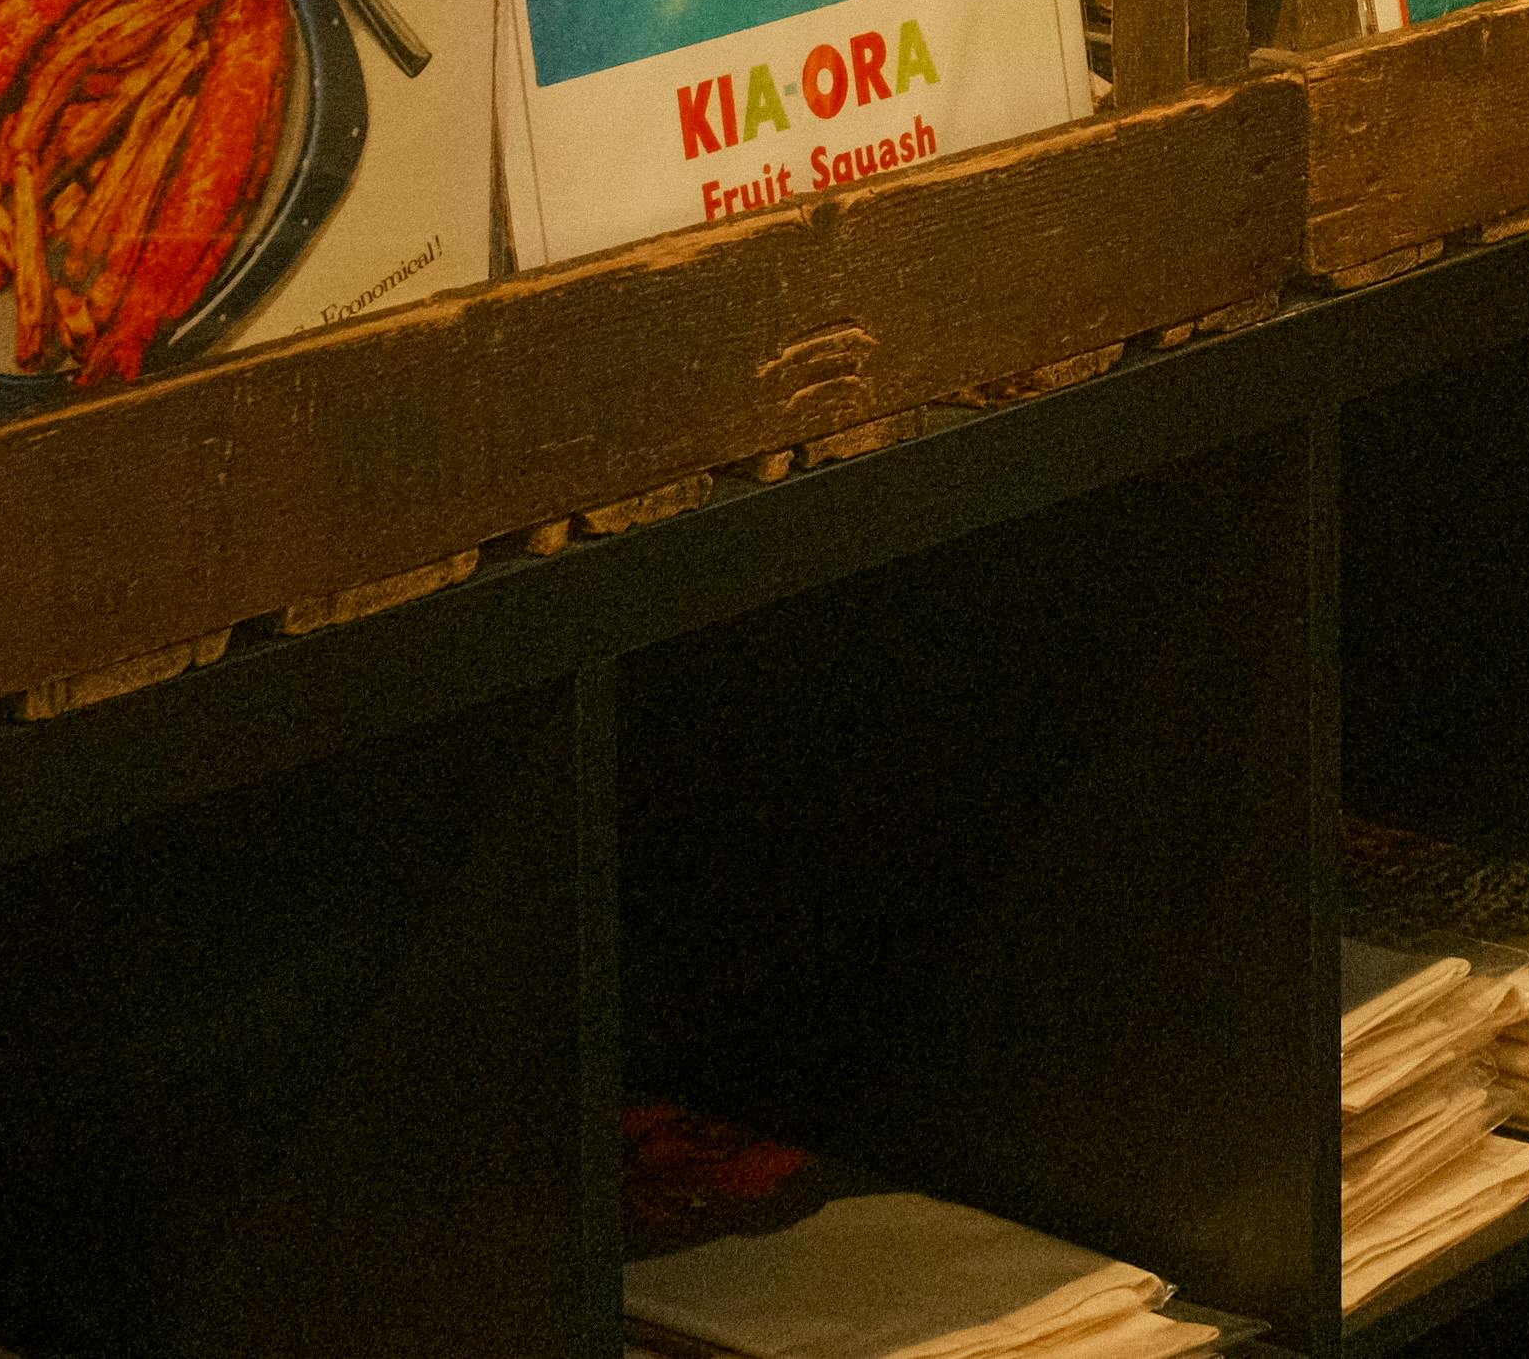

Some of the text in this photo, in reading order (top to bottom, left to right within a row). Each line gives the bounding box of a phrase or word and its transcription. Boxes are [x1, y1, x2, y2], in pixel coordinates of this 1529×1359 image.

[676, 17, 942, 162] KIA-ORA
[701, 114, 938, 224] Fruit Squash
[319, 233, 444, 325] Economical!
